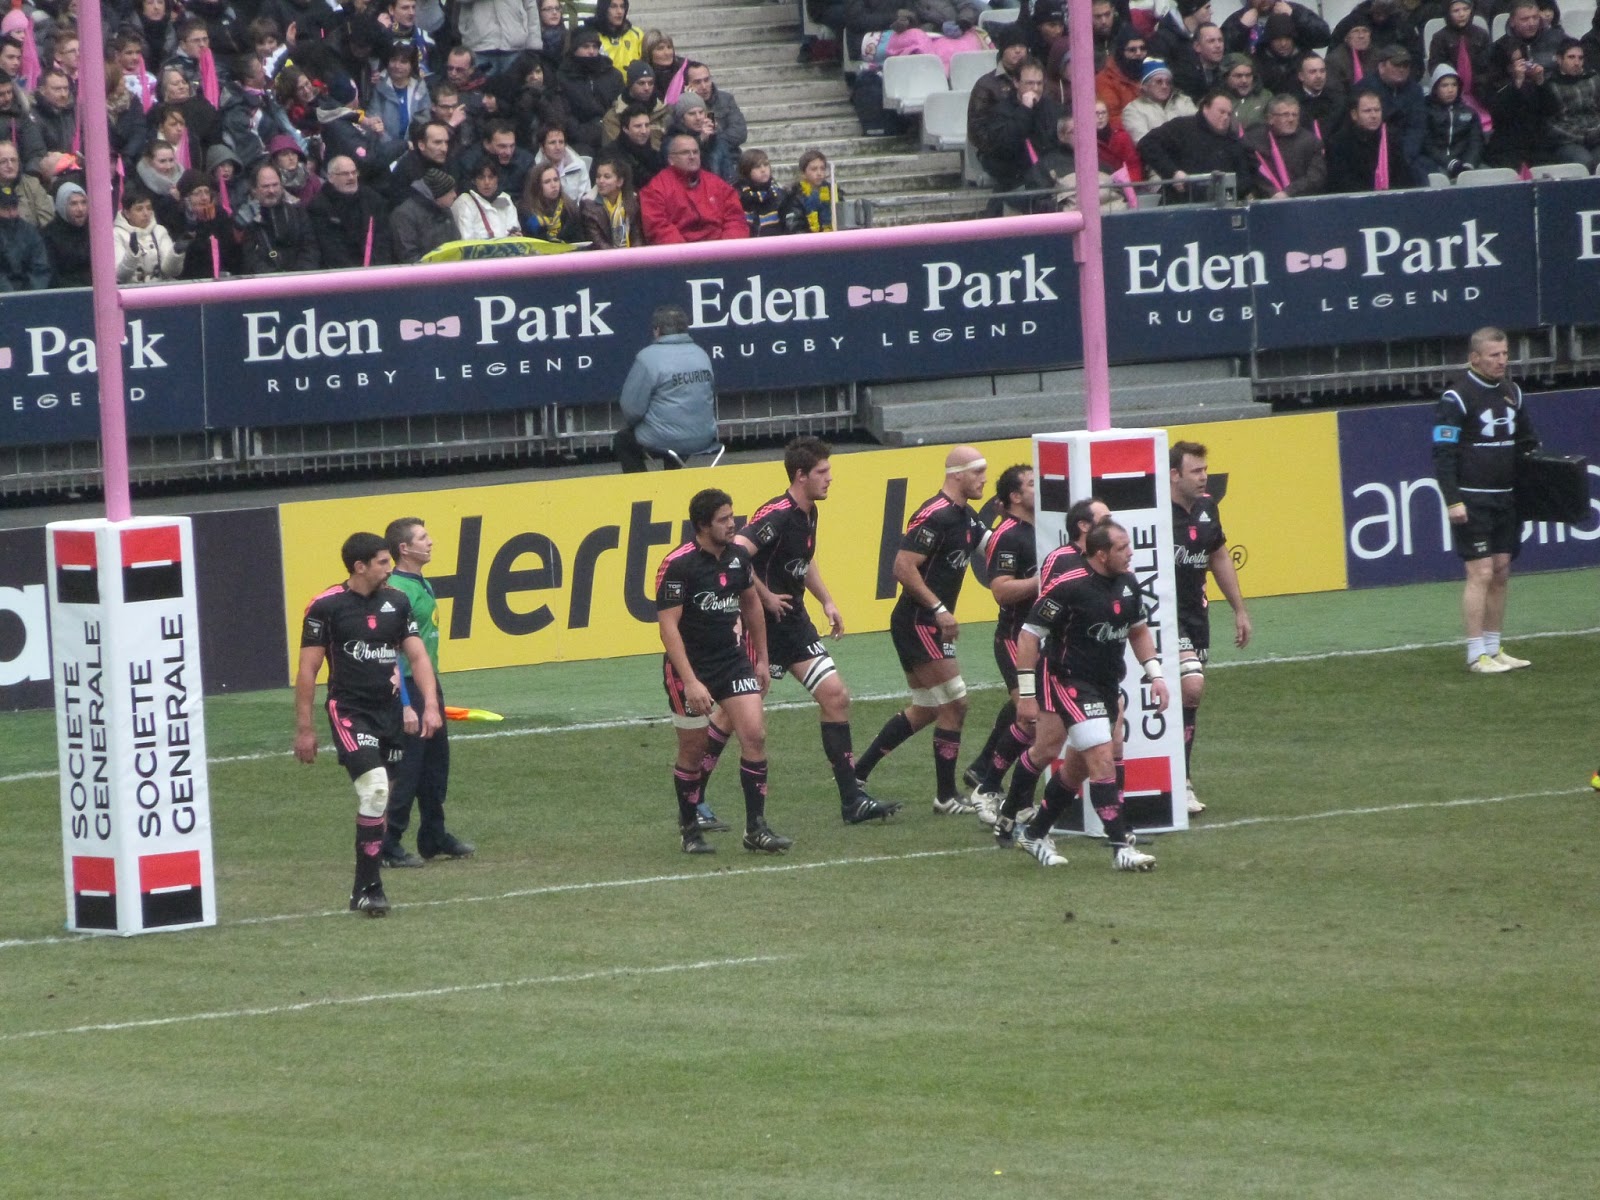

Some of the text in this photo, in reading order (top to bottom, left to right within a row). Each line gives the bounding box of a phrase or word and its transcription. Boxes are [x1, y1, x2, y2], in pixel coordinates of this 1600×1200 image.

[685, 254, 1059, 329] Eden Park
[1124, 219, 1502, 296] Eden Park
[242, 288, 614, 363] Eden Park
[712, 320, 1037, 359] RUGBY LEGEND
[1148, 287, 1481, 326] RUGBY LEGEND
[25, 318, 168, 377] Pak
[267, 355, 593, 393] RUGBY LEGEND
[12, 386, 146, 411] EGED
[425, 499, 749, 641] Hert
[1046, 601, 1060, 611] TOP
[63, 661, 88, 840] SOCIETE
[83, 620, 112, 841] GENERALE
[129, 658, 162, 839] SOCIETE
[160, 613, 197, 835] GENERALE
